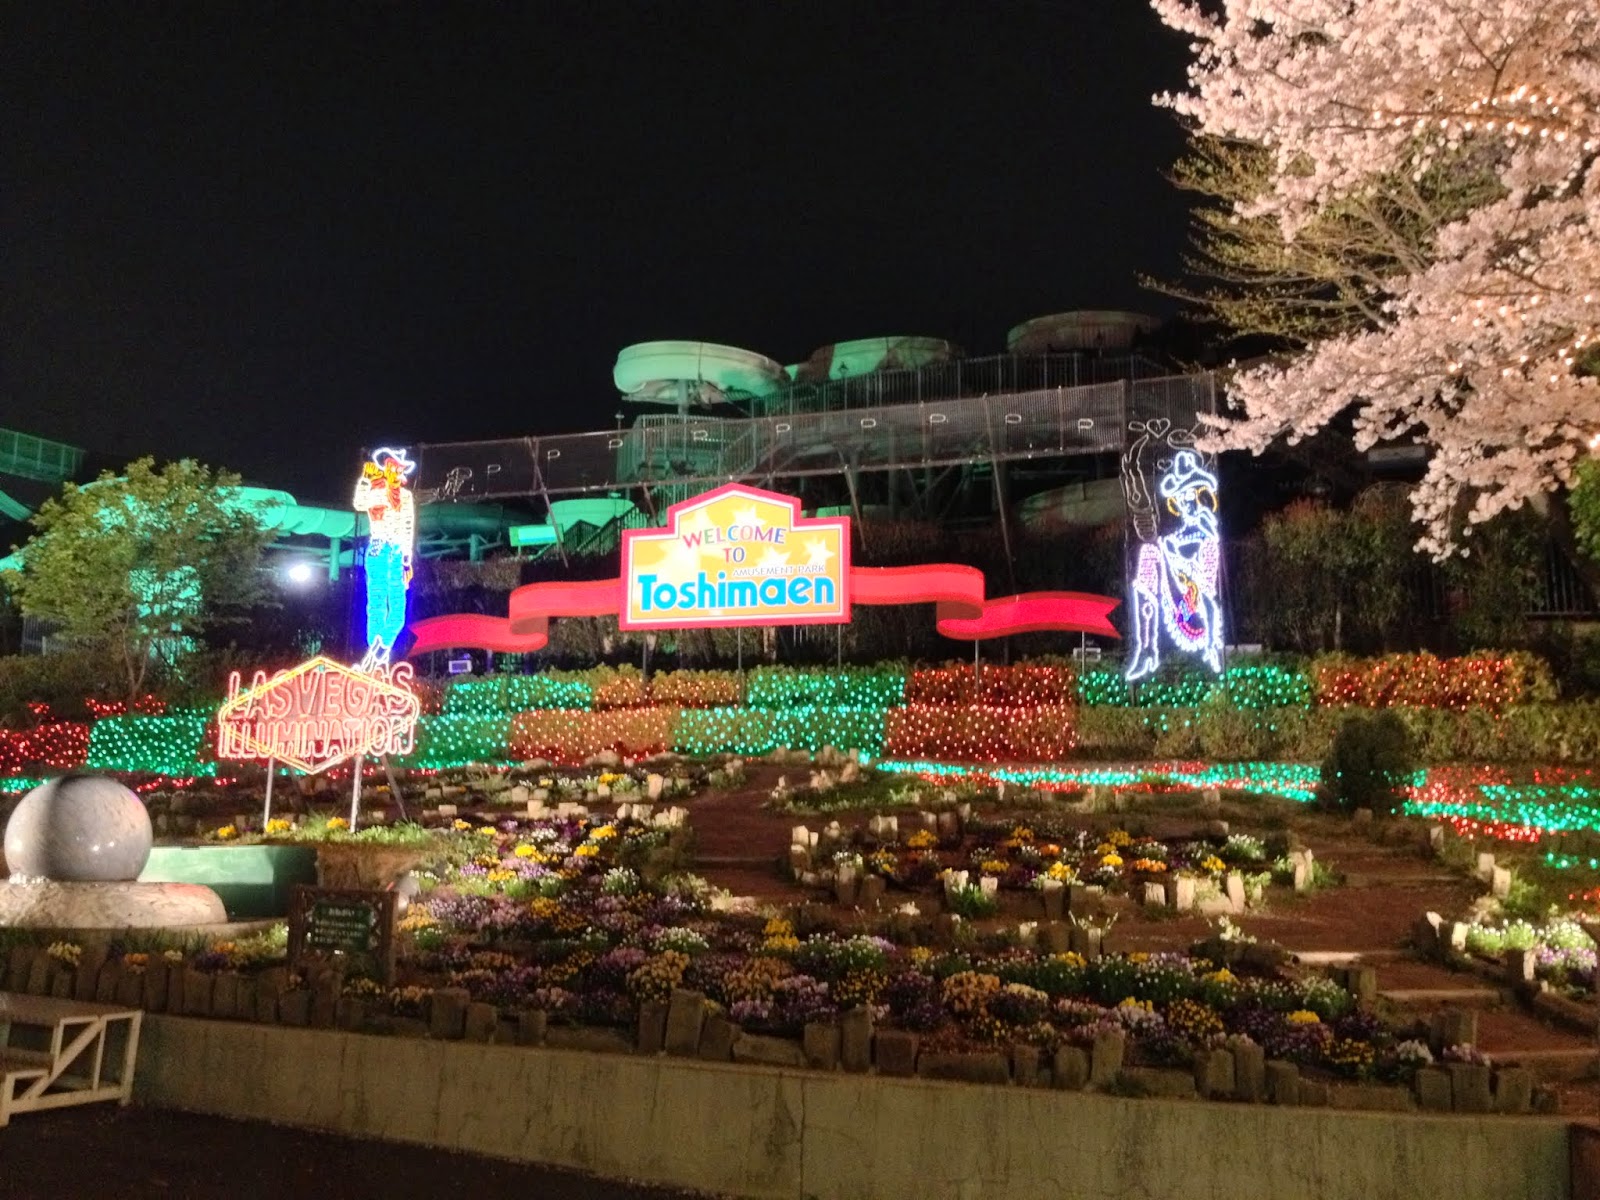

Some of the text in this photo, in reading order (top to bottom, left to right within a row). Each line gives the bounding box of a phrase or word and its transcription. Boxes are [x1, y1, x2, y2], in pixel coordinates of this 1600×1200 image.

[682, 525, 787, 548] WELCOME
[724, 547, 745, 563] TO
[733, 564, 825, 577] AMUSEMENT PARK
[637, 571, 835, 611] Toshimaen
[218, 716, 415, 758] ILLUMINATION
